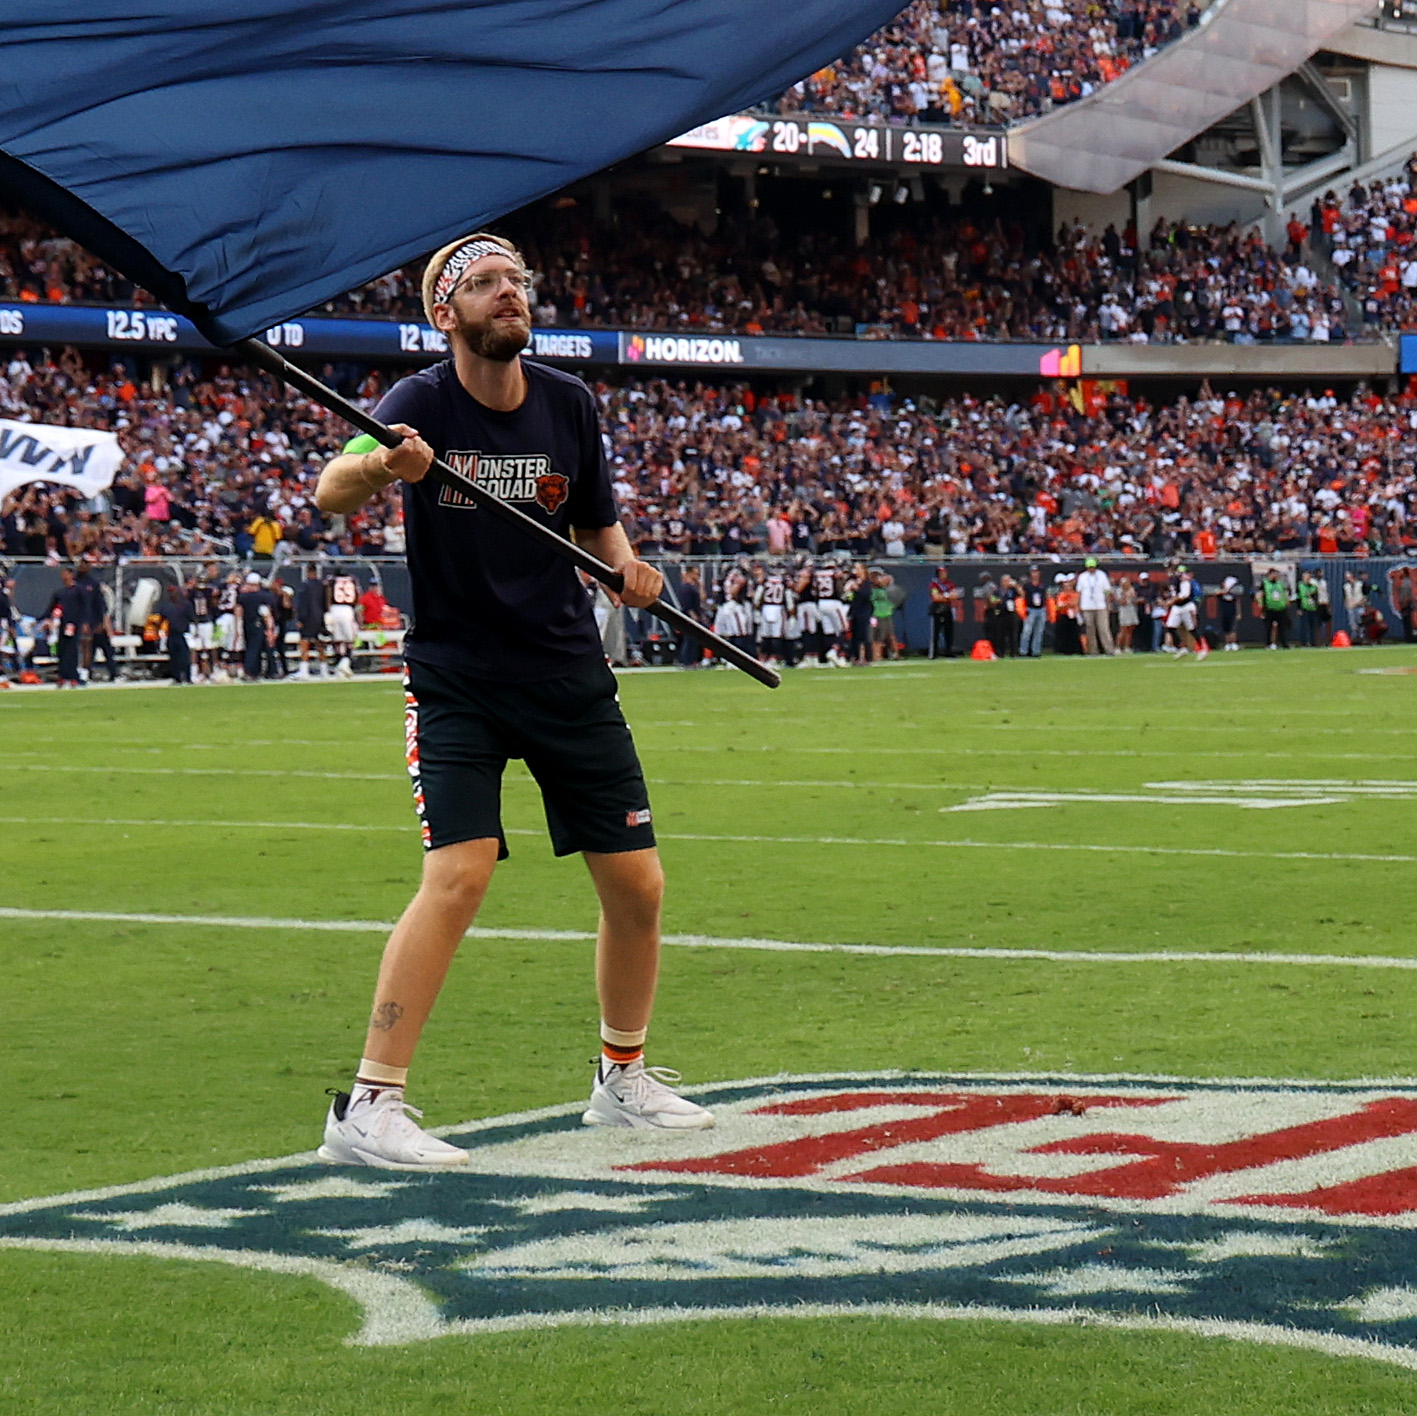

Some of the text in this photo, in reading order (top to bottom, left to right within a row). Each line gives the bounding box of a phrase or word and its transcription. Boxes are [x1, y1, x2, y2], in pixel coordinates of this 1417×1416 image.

[772, 122, 798, 152] 20
[854, 128, 878, 158] 24
[903, 133, 942, 163] 2:18
[963, 136, 997, 166] 3rd
[106, 310, 178, 342] 12.5 YPC
[284, 322, 304, 347] TD
[399, 324, 420, 351] 12
[535, 335, 592, 358] TARGETS
